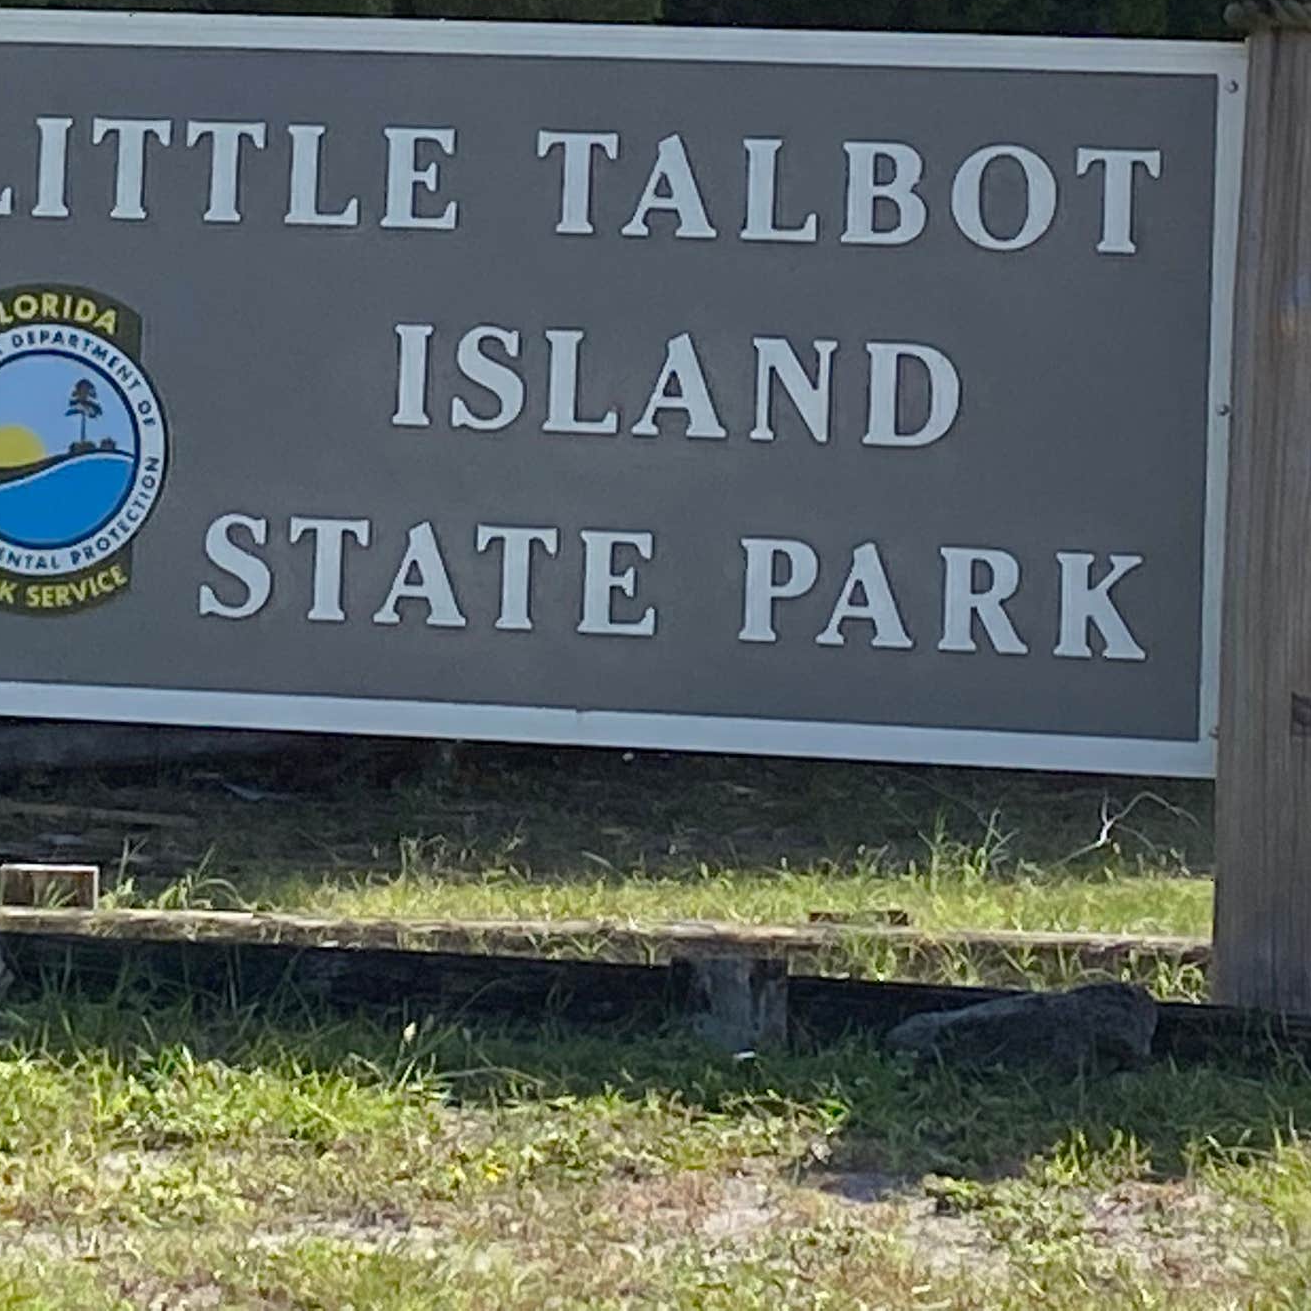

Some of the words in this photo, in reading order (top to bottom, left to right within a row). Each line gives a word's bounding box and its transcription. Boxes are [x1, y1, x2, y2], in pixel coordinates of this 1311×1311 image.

[535, 129, 1162, 255] TALBOT
[12, 330, 141, 391] DEPARTMENT
[138, 400, 155, 427] OF
[390, 323, 961, 448] ISLAND
[71, 457, 160, 566] PROTECTION
[24, 566, 129, 608] SERVICE
[199, 513, 655, 637] STATE
[739, 537, 1145, 661] PARK
